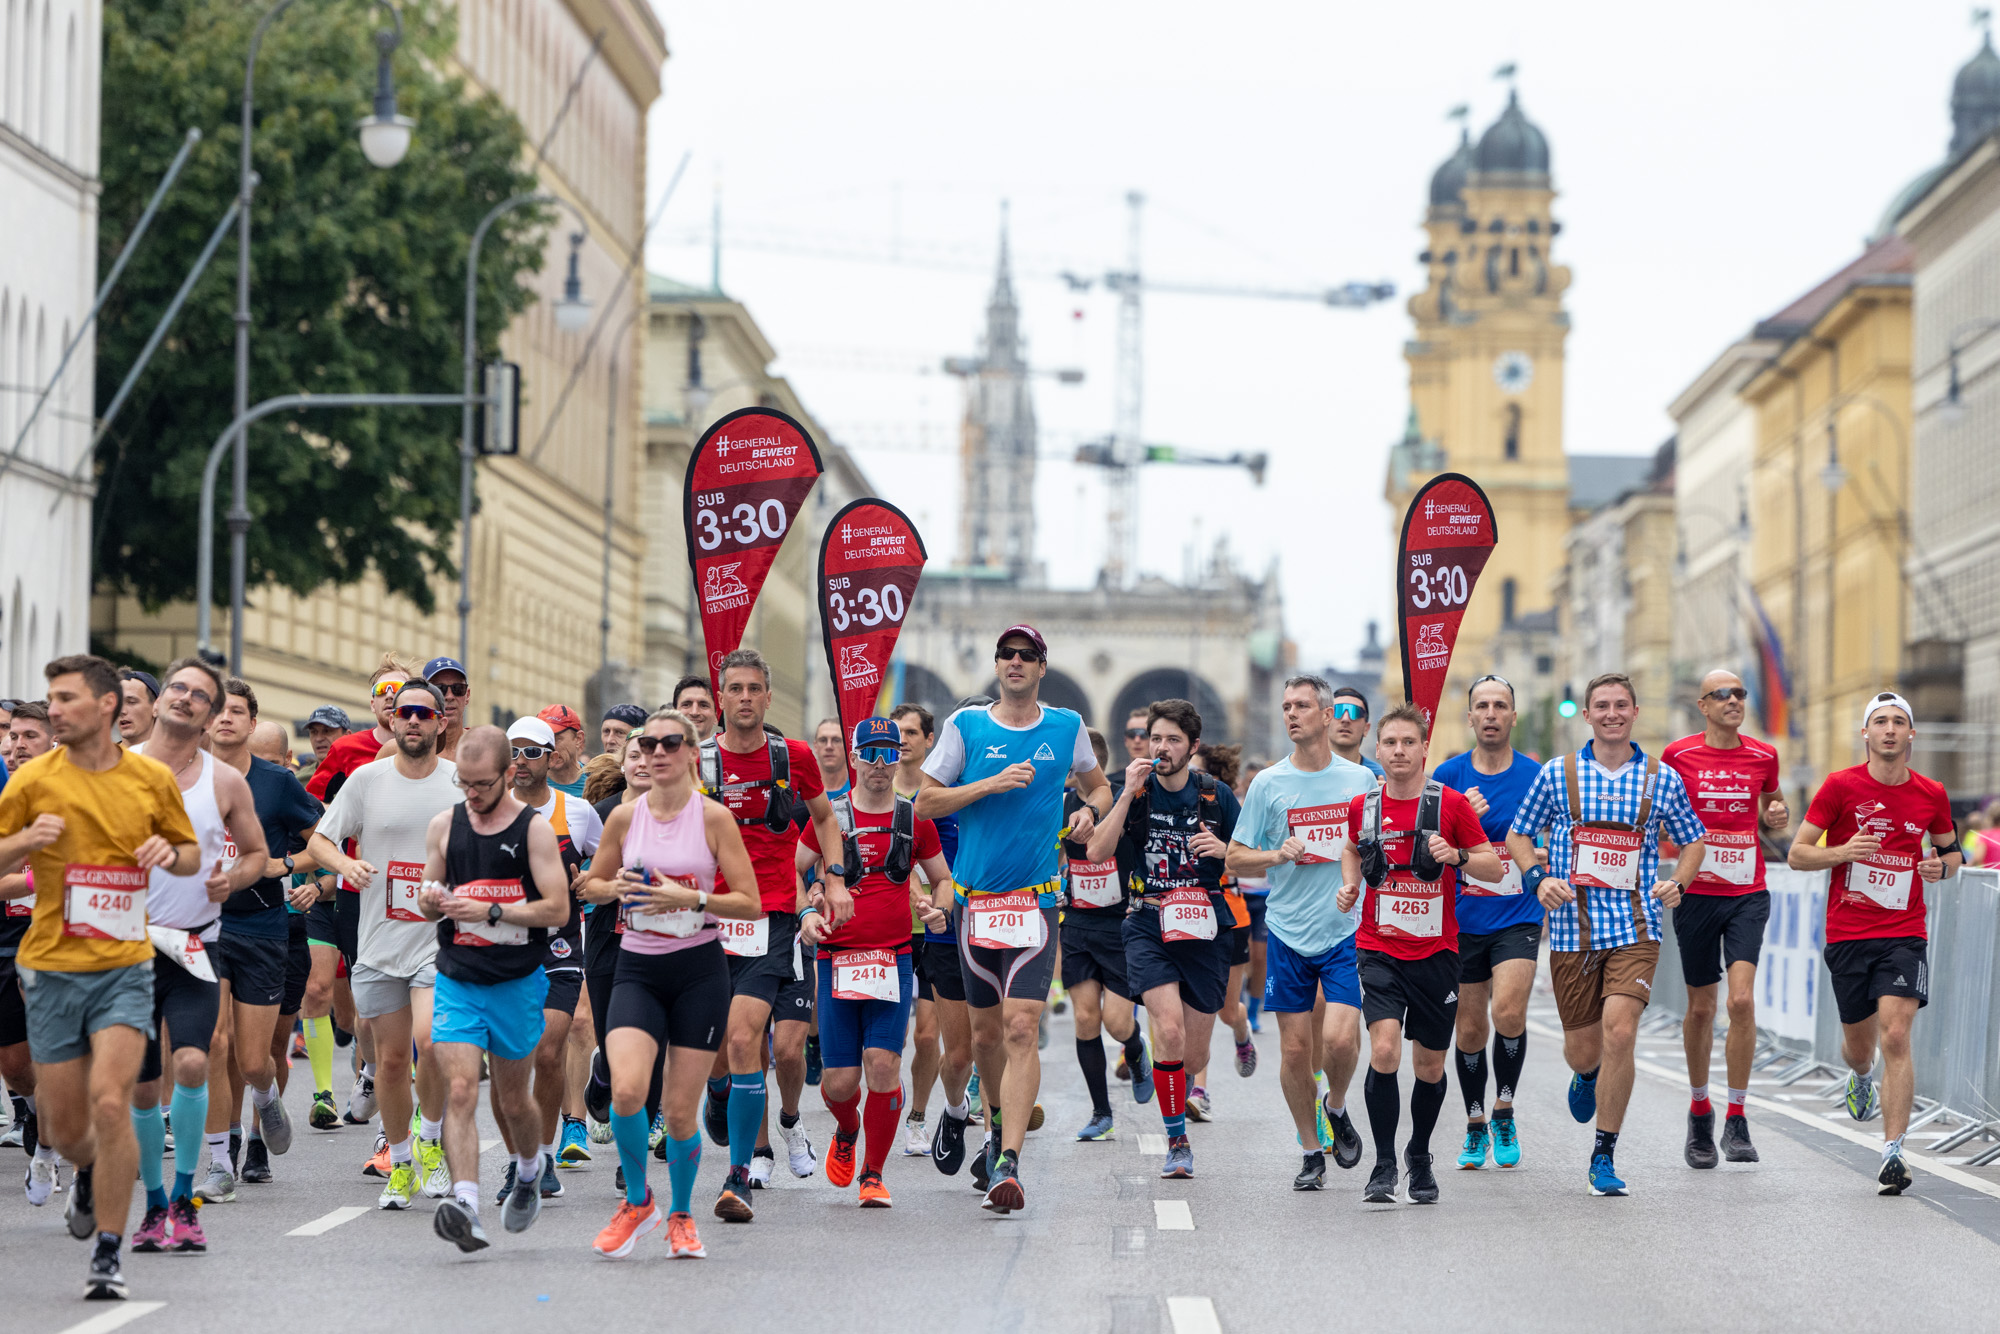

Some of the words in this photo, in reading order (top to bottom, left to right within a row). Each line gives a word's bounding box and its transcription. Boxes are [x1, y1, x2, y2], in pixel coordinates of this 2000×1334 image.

[716, 436, 781, 458] #GENERALI
[752, 446, 798, 459] BEWEGT
[719, 457, 795, 474] DEUTSCHLAND
[697, 492, 726, 508] SUB
[1425, 499, 1470, 520] #GENERALI
[696, 498, 787, 551] 3:30
[1449, 515, 1482, 525] BEWEGT
[841, 523, 893, 545] #GENERALI
[1427, 525, 1478, 537] DEUTSCHLAND
[870, 535, 907, 547] BEWEGT
[844, 546, 906, 561] DEUTSCHLAND
[1411, 553, 1433, 567] SUB
[828, 576, 851, 592] SUB
[1410, 565, 1468, 610] 3:30
[706, 594, 751, 615] GENERALI
[829, 583, 905, 633] 3:30
[1597, 794, 1625, 802] uhlsport
[1307, 826, 1343, 842] 4794
[1591, 832, 1640, 847] GENERALI
[1712, 833, 1756, 845] GENERALI
[1593, 850, 1627, 867] 1988
[1713, 850, 1745, 864] 1854
[86, 870, 146, 886] GENERALI
[1080, 877, 1107, 891] 4737
[1868, 870, 1896, 887] 570
[469, 884, 524, 897] GENERALI
[1390, 882, 1442, 893] GENERALI
[88, 893, 133, 913] 4240
[986, 896, 1037, 909] GENERALI
[1172, 891, 1211, 903] GENERA
[1175, 906, 1209, 920] 3894
[1391, 900, 1430, 916] 4263
[717, 921, 755, 937] 2168
[988, 913, 1024, 929] 2701
[849, 950, 895, 964] GENERALI
[852, 966, 887, 982] 2414
